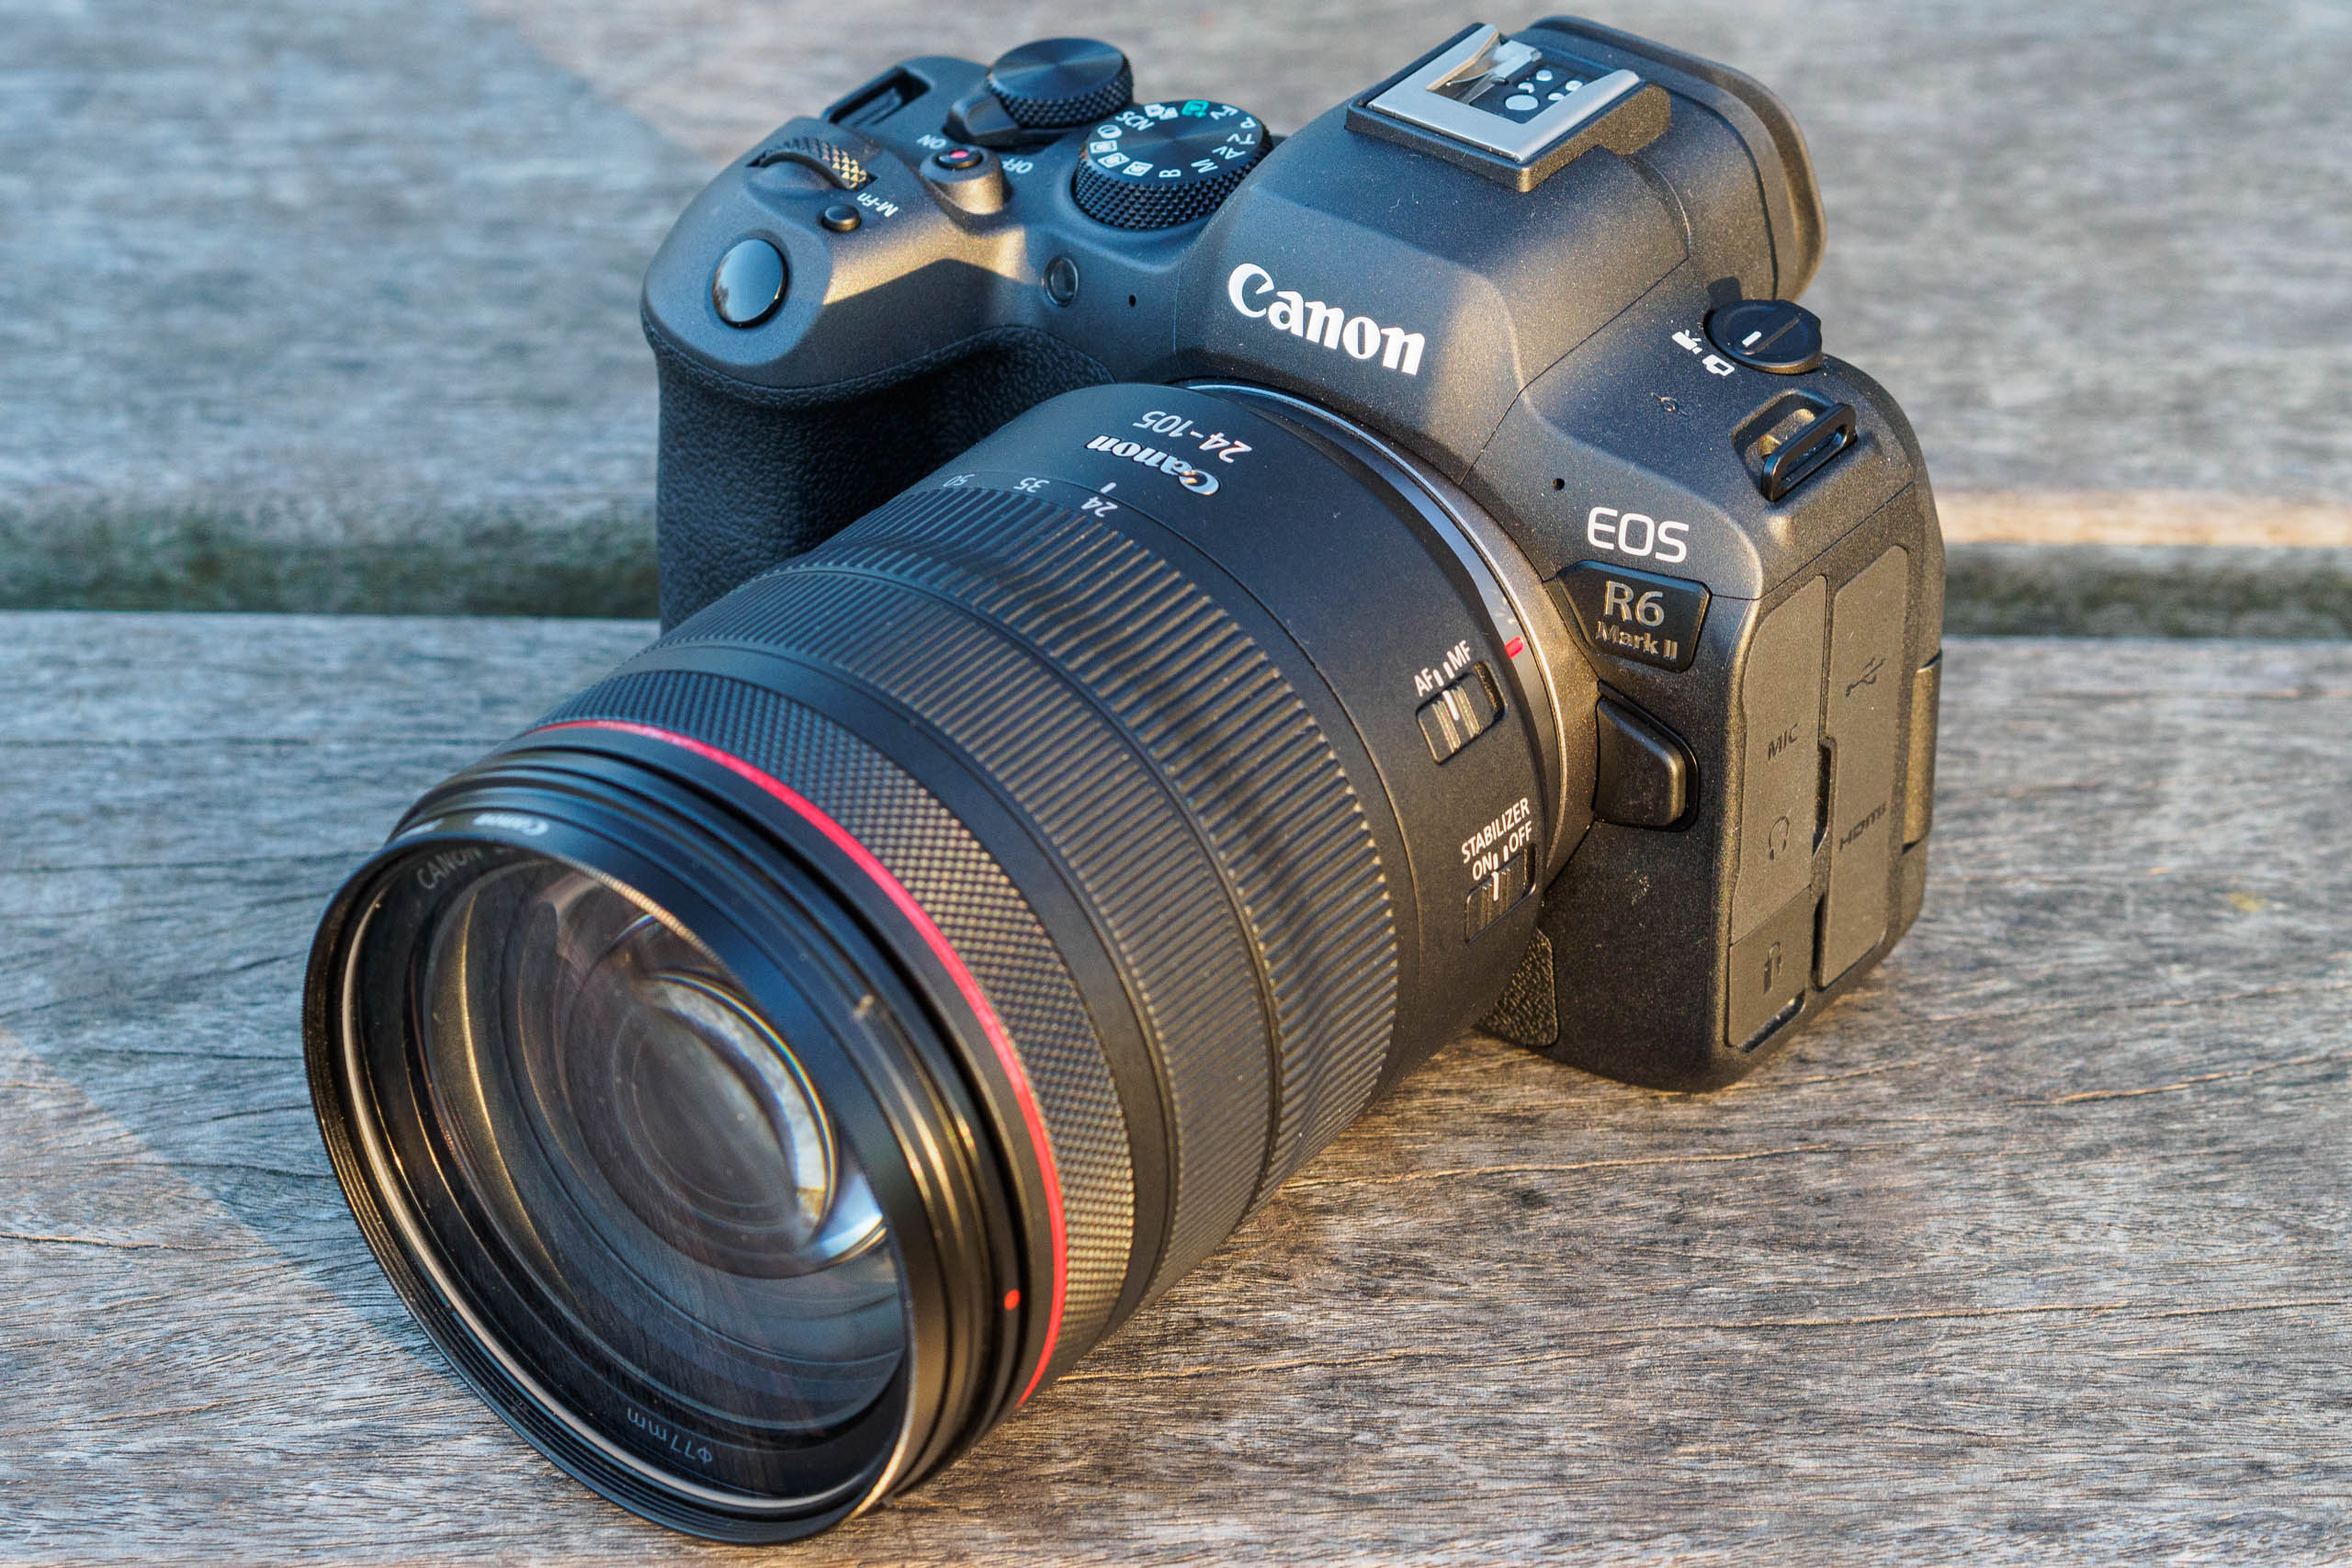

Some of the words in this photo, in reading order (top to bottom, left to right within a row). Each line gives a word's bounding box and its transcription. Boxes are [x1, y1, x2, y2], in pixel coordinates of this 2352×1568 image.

[1115, 111, 1155, 131] SCN
[1240, 117, 1257, 130] P
[917, 134, 946, 150] ON
[1212, 145, 1247, 160] Av
[1227, 132, 1256, 145] Tv
[1159, 169, 1182, 178] B
[1191, 158, 1218, 174] M
[856, 192, 899, 218] M-Fn
[1227, 263, 1426, 376] Canon
[1132, 411, 1252, 463] 24-105
[943, 474, 975, 488] 50
[1085, 435, 1220, 496] Canon
[1013, 477, 1049, 492] 35
[1080, 496, 1118, 518] 24
[1587, 506, 1690, 563] EOS
[1604, 580, 1665, 627] R6
[1595, 620, 1659, 655] Mark
[1663, 638, 1679, 660] II
[1413, 668, 1434, 697] AF
[1446, 639, 1472, 671] MF
[1768, 723, 1798, 761] MIC
[1461, 797, 1531, 864] STABILIZER
[1838, 801, 1886, 852] HDMI
[1472, 852, 1493, 881] ON
[1509, 820, 1532, 852] OFF
